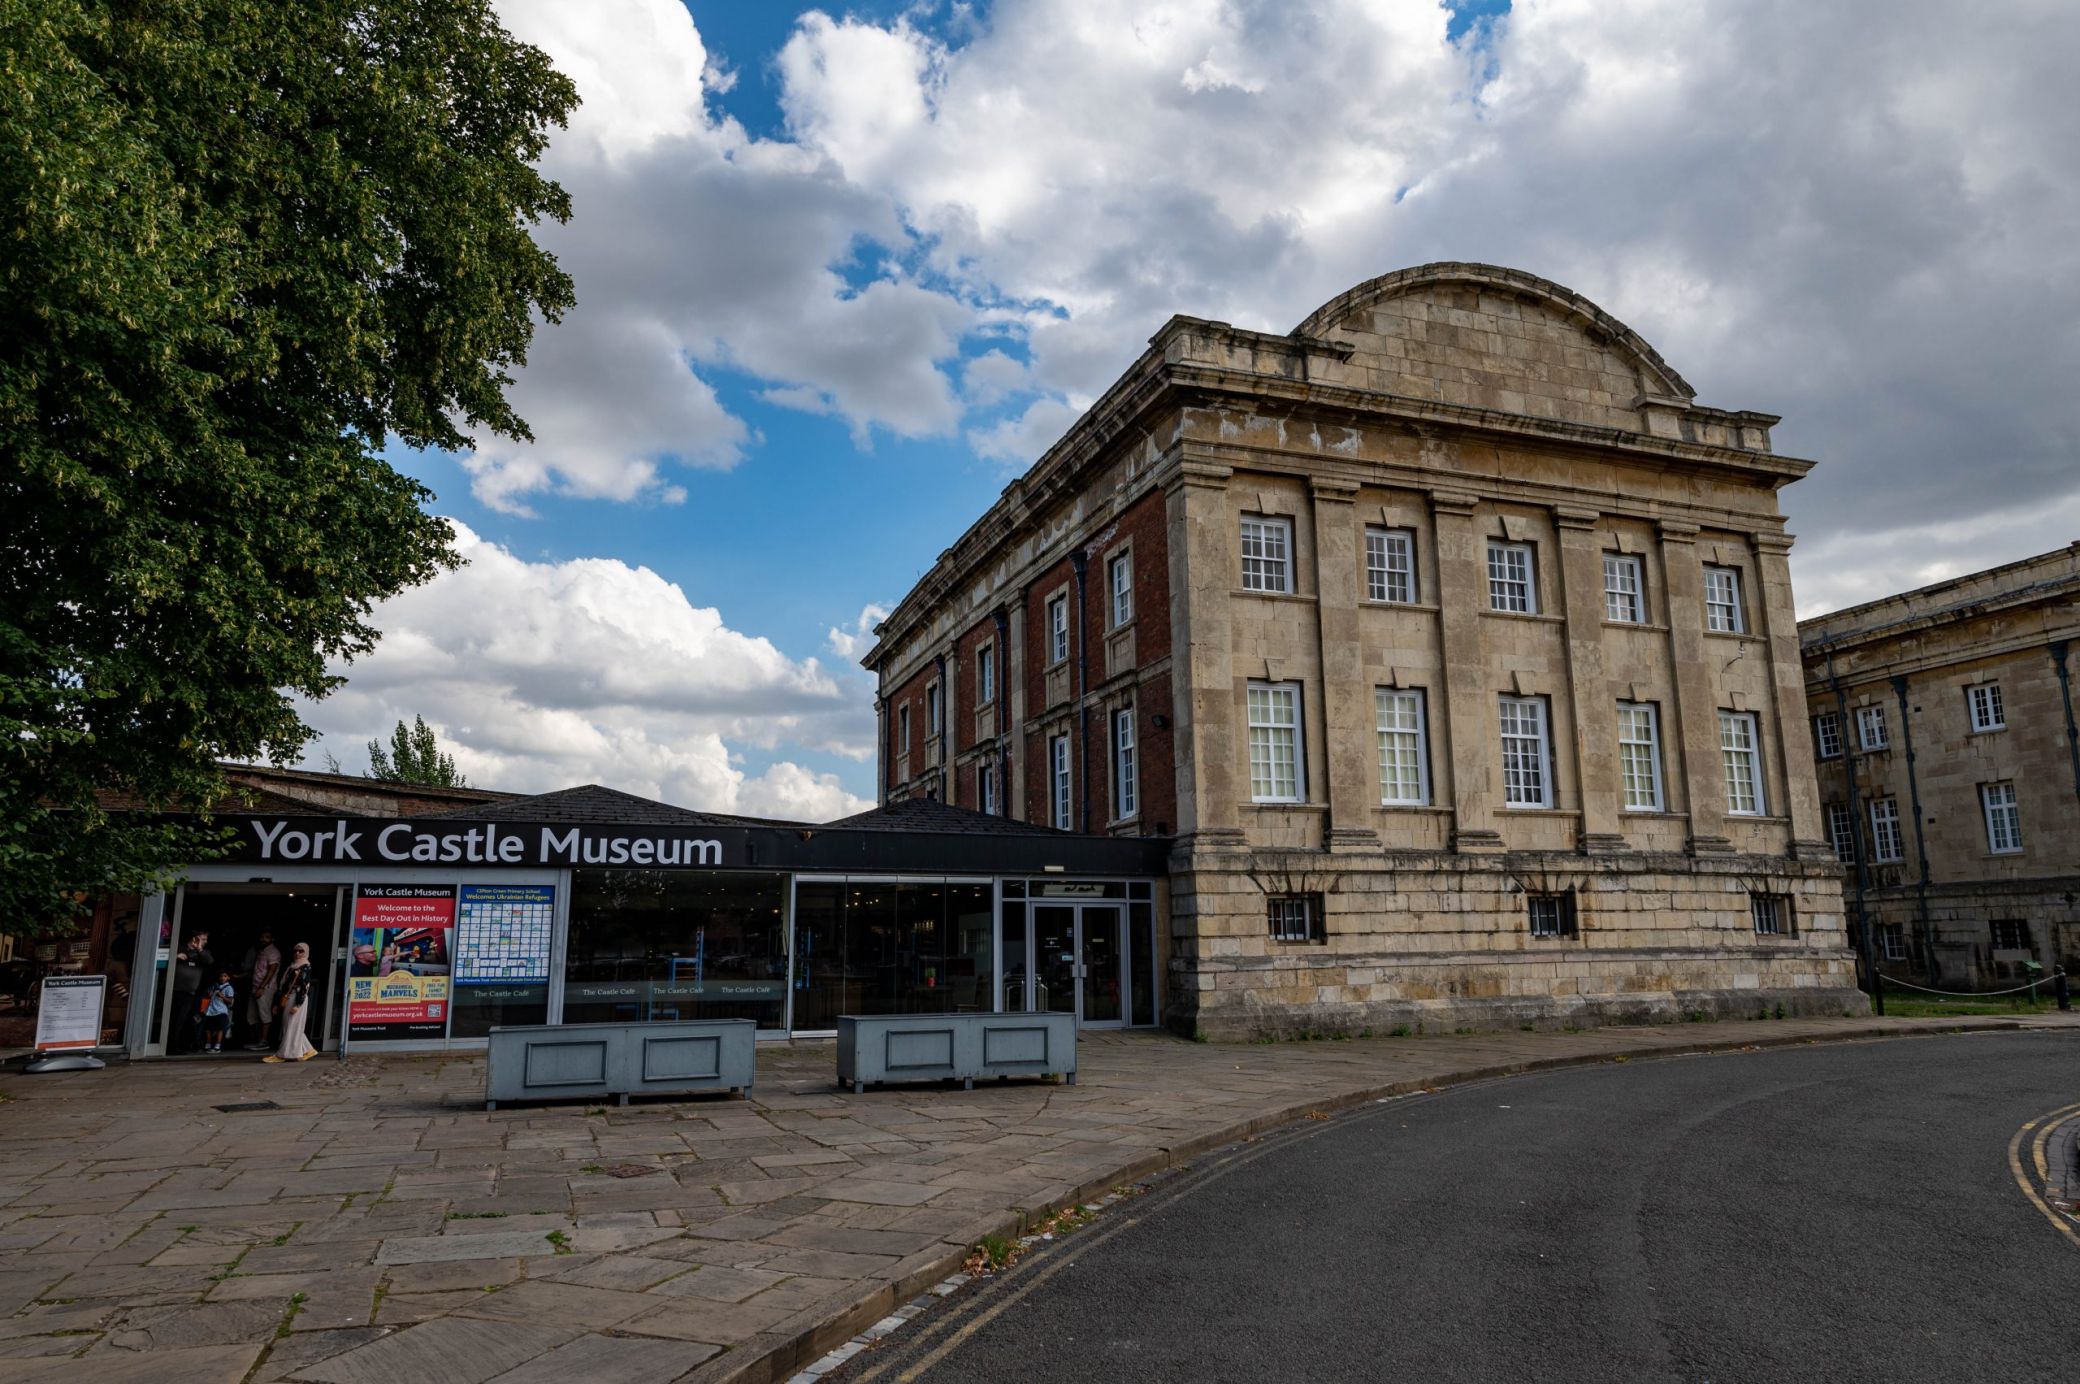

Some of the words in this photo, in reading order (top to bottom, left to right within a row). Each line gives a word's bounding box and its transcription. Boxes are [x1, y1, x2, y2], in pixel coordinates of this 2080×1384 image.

[250, 819, 363, 861] York
[377, 822, 525, 863] Castle
[539, 826, 723, 866] Museum
[364, 887, 384, 896] York
[385, 888, 413, 897] Castle
[414, 888, 451, 897] Museum
[377, 904, 412, 912] Welcome
[423, 904, 436, 912] the
[362, 914, 378, 922] Best
[380, 914, 395, 924] Day
[421, 915, 448, 924] History
[355, 980, 372, 989] NEW
[755, 985, 771, 993] Café
[380, 989, 418, 999] MARVELS
[473, 990, 488, 998] The
[582, 988, 596, 996] The
[619, 987, 636, 995] Café
[689, 986, 705, 994] Café
[354, 991, 371, 1000] 2022
[353, 1011, 423, 1020] yorkcastlemuseum.org.uk
